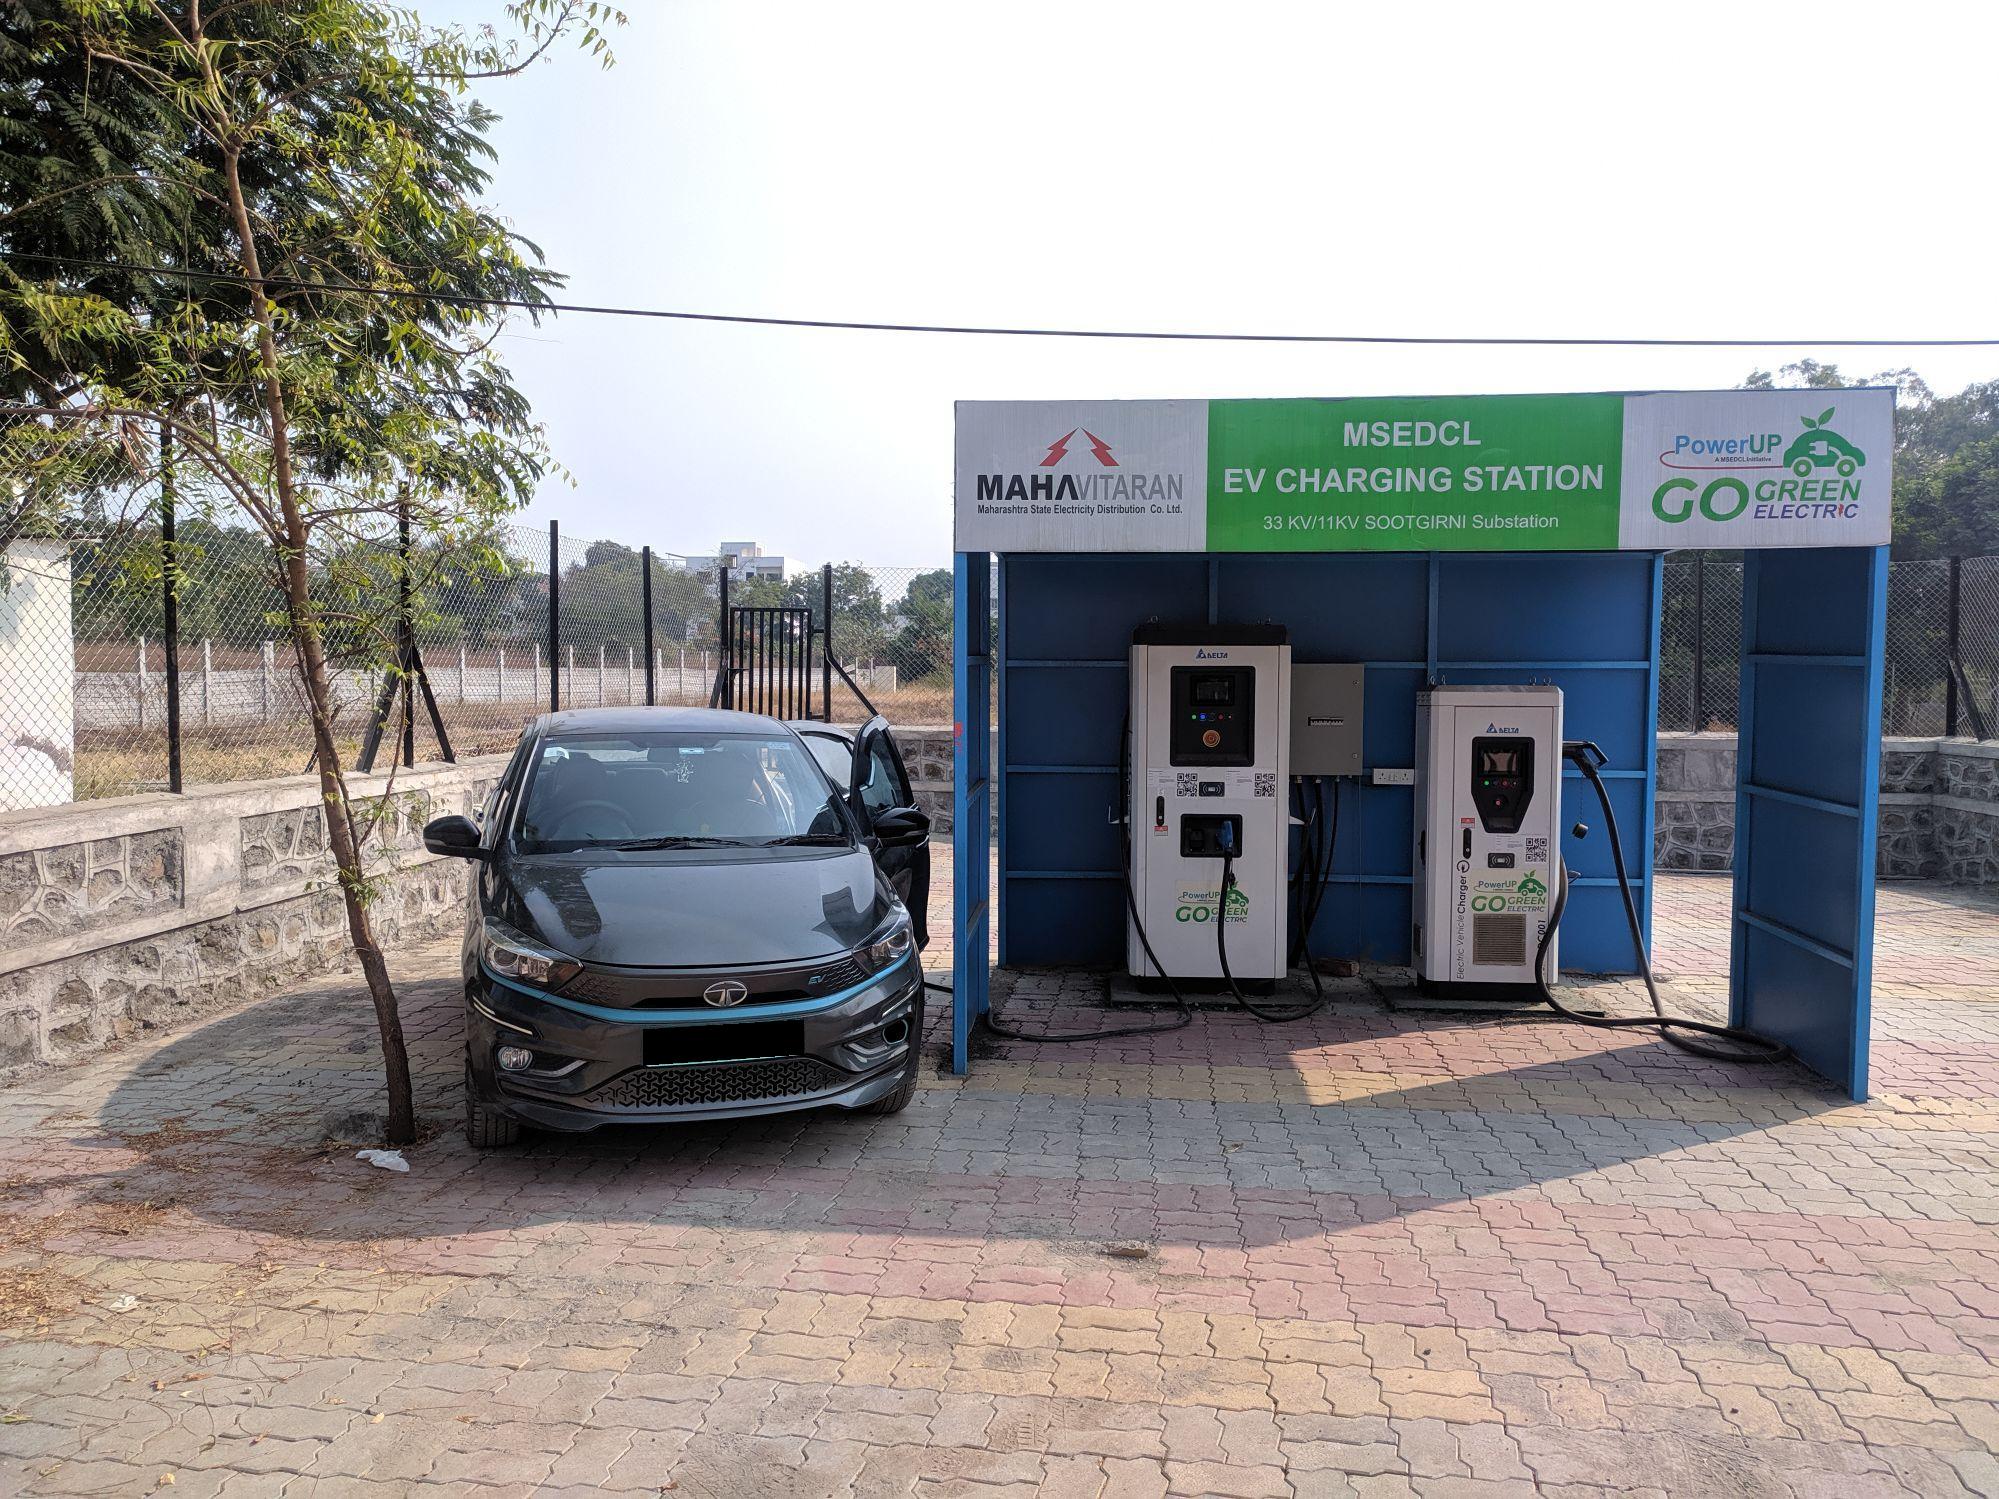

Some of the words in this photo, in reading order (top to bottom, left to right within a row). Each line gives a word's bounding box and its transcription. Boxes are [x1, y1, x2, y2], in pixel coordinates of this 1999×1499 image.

[1343, 420, 1482, 447] MSEDCL
[1675, 433, 1782, 455] PowerUP
[1224, 468, 1266, 493] EV
[1275, 467, 1452, 493] CHARGING
[1463, 464, 1603, 492] STATION
[977, 474, 1183, 501] MAHAVITARAN
[1652, 477, 1750, 524] GO
[1754, 479, 1862, 502] GREEN
[977, 504, 1028, 515] Maharashtra
[1030, 504, 1052, 515] State
[1053, 504, 1095, 517] Electricity
[1097, 504, 1146, 514] Distribution
[1150, 504, 1165, 515] Co.
[1166, 504, 1183, 514] Ltd.
[1753, 503, 1859, 520] ELECTRIC
[1263, 515, 1283, 530] 33
[1288, 515, 1360, 530] KV/11KV
[1365, 514, 1466, 530] SOOTGIRNI
[1472, 513, 1559, 529] Substation
[1476, 880, 1518, 889] PowerUP
[1182, 891, 1221, 899] PowerUP
[1457, 875, 1468, 914] Charger
[1471, 895, 1507, 912] GO
[1507, 896, 1546, 905] GREEN
[1175, 906, 1210, 923] GO
[1211, 907, 1248, 916] GEEN
[1456, 948, 1465, 980] Electric
[808, 975, 826, 985] EV
